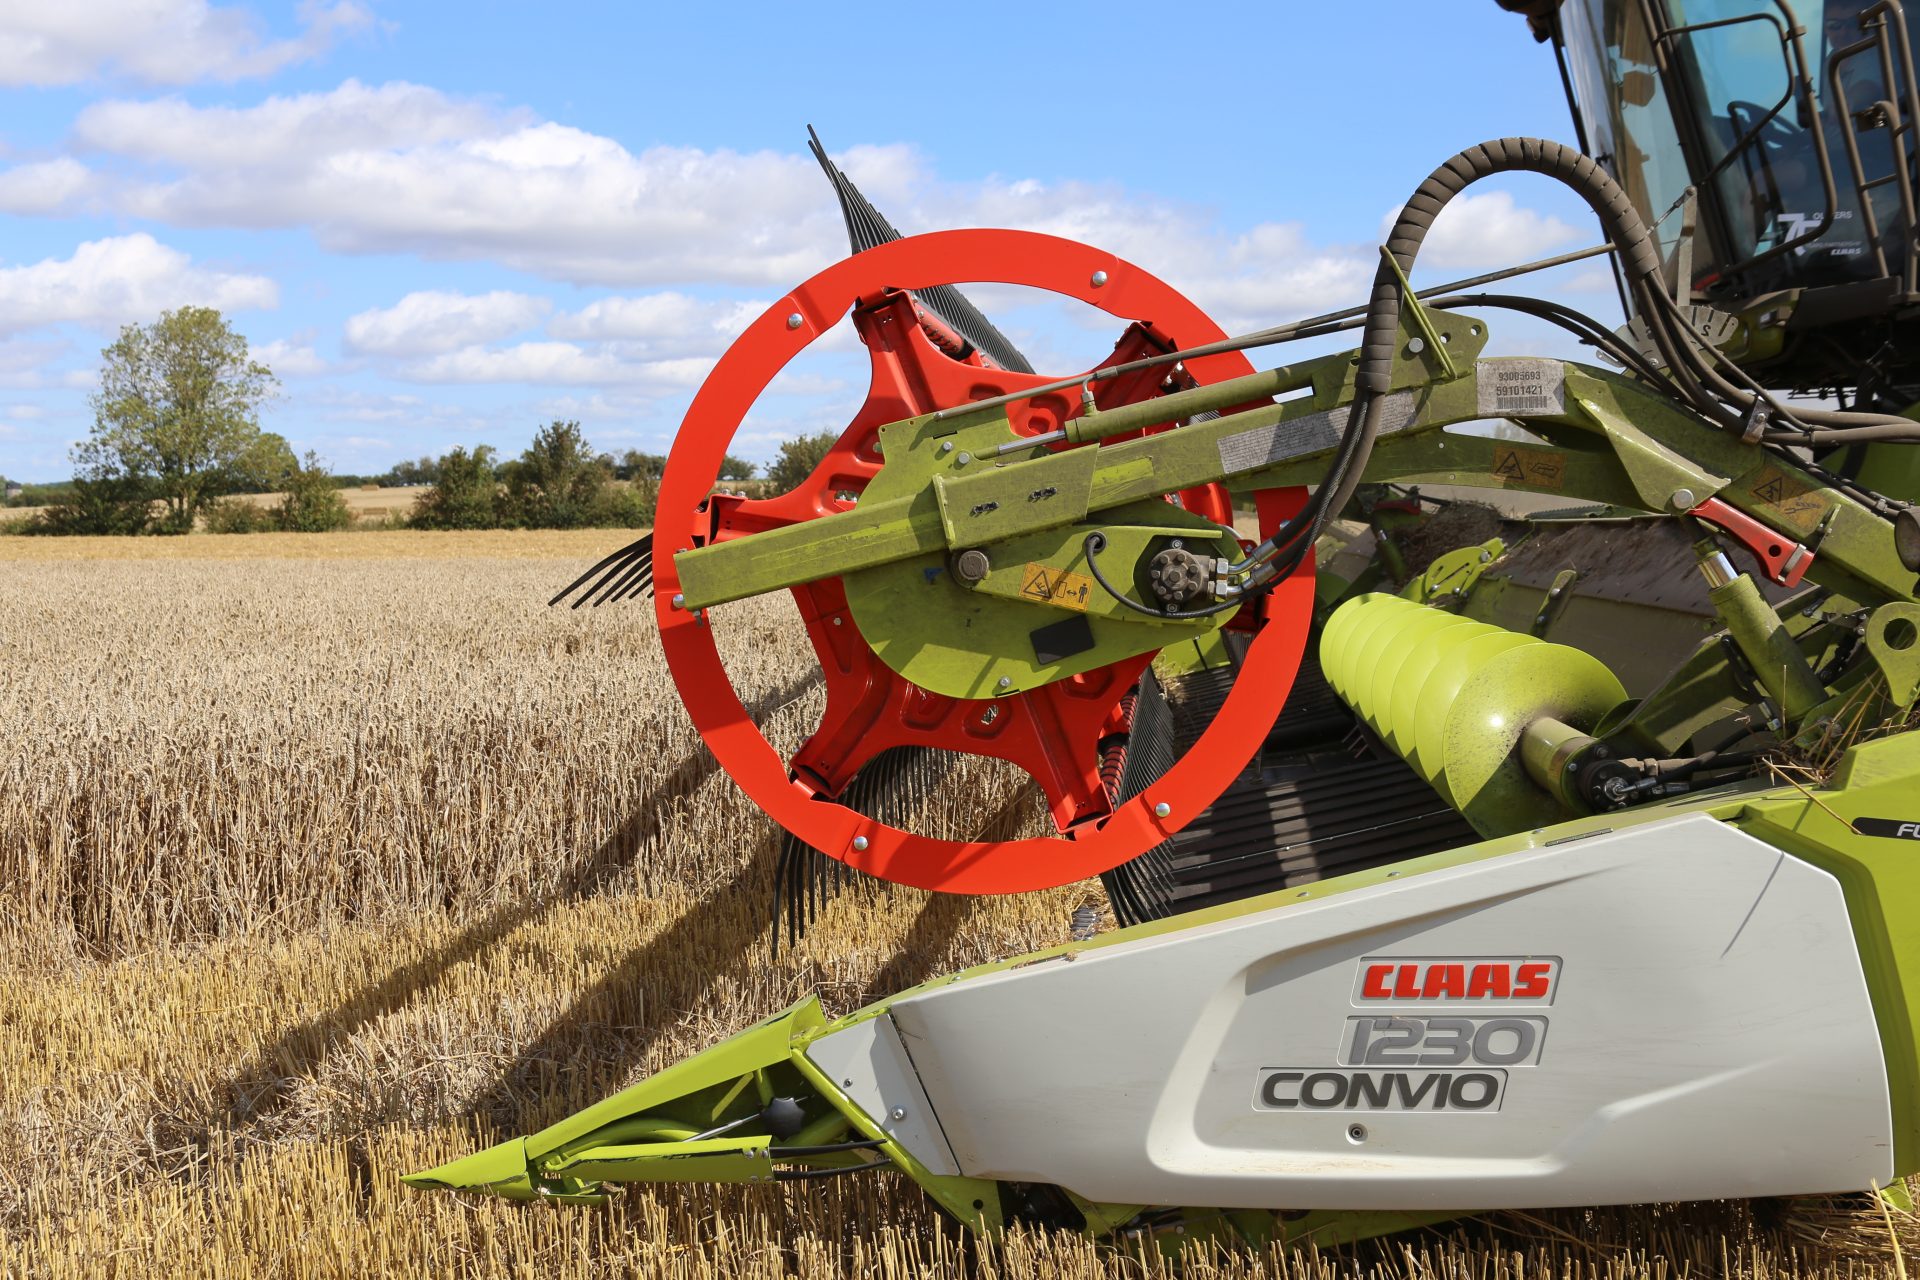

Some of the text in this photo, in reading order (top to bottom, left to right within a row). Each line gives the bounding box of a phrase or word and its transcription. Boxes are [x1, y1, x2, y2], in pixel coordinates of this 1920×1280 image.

[1812, 211, 1853, 220] OLERS
[1496, 385, 1543, 396] 59101421
[1360, 963, 1551, 1000] CLAAS
[1347, 1018, 1536, 1066] 1230
[1260, 1072, 1499, 1110] CONVIO
